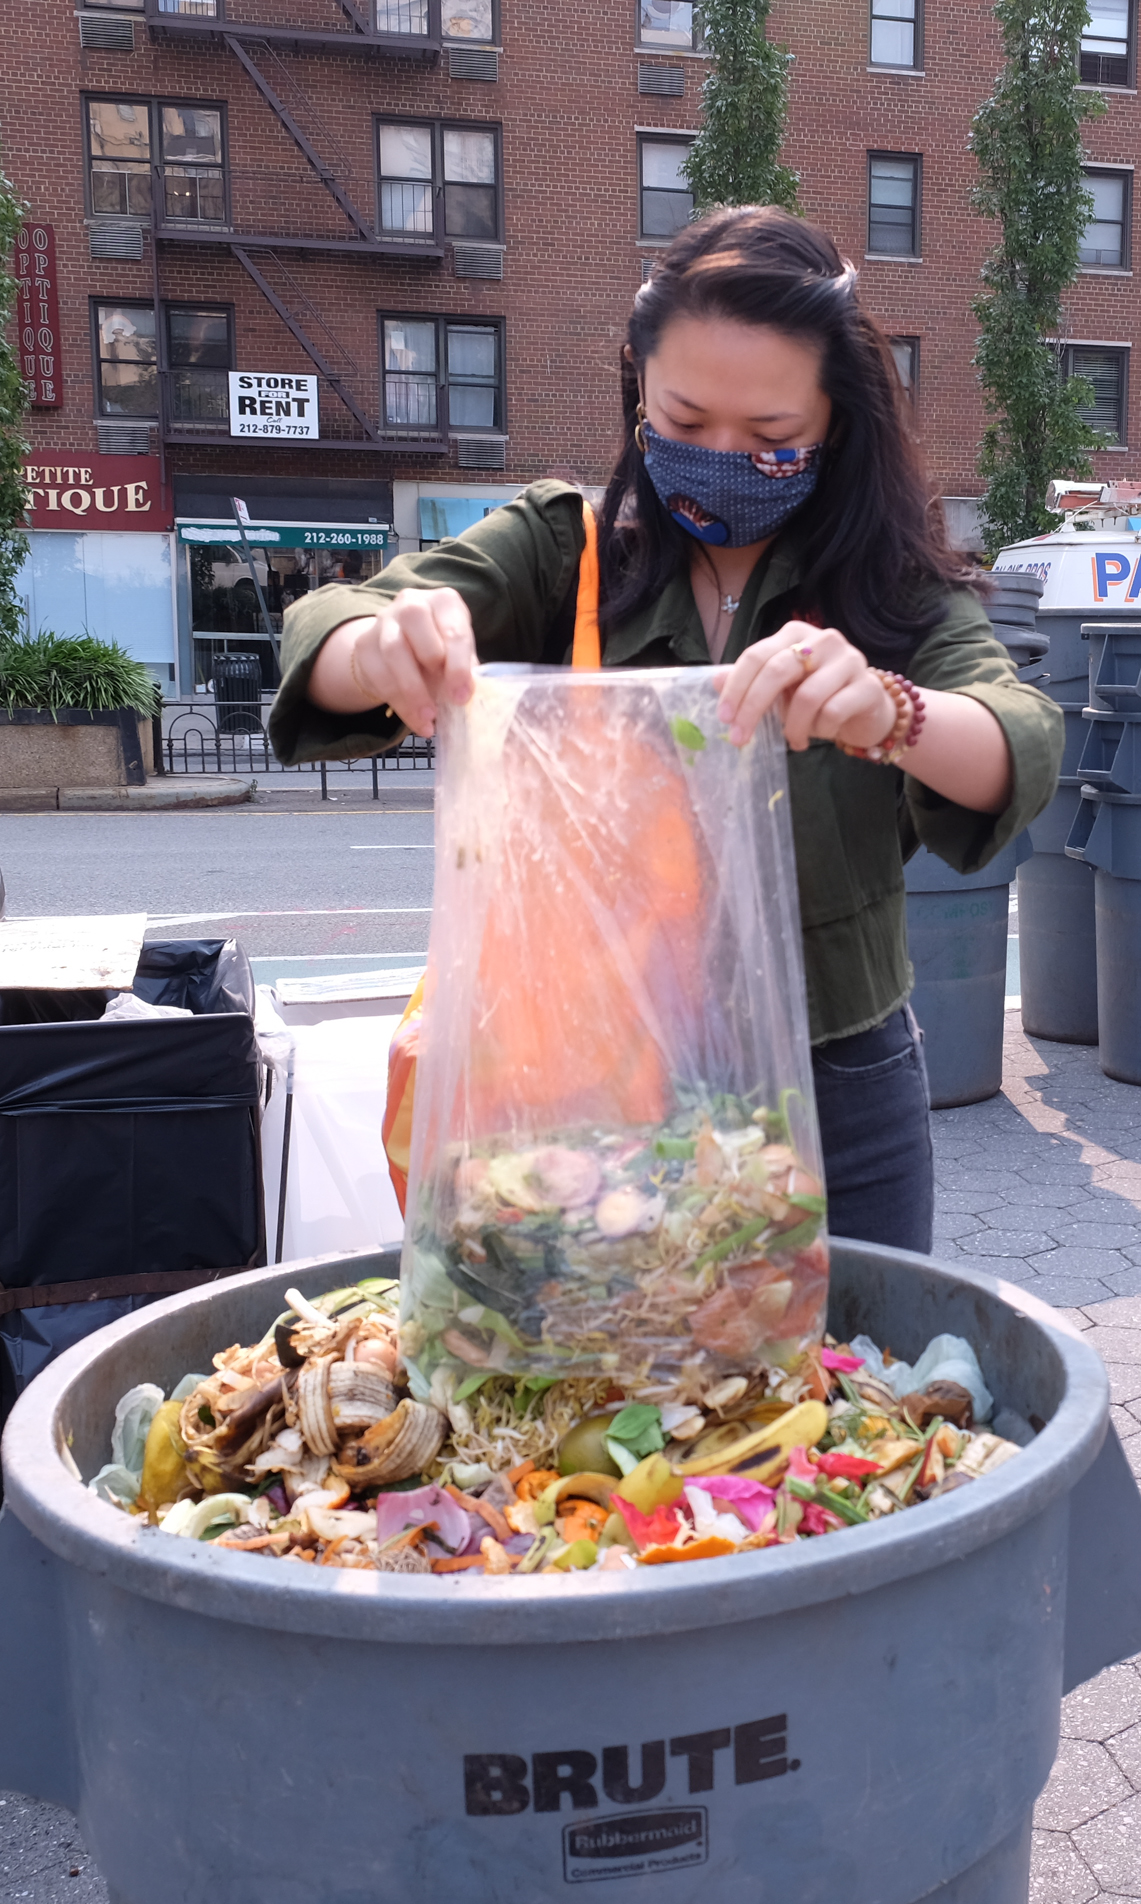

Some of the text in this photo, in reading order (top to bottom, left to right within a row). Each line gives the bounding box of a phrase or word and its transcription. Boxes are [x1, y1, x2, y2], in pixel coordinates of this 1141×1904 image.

[33, 228, 56, 402] OPTIQUE
[238, 375, 308, 392] STORE
[238, 395, 310, 418] RENT
[239, 423, 310, 436] 212-879-7737
[304, 532, 384, 545] 212-260-1988
[574, 1819, 698, 1850] Rubbermaid
[570, 1852, 702, 1879] Commercial Products
